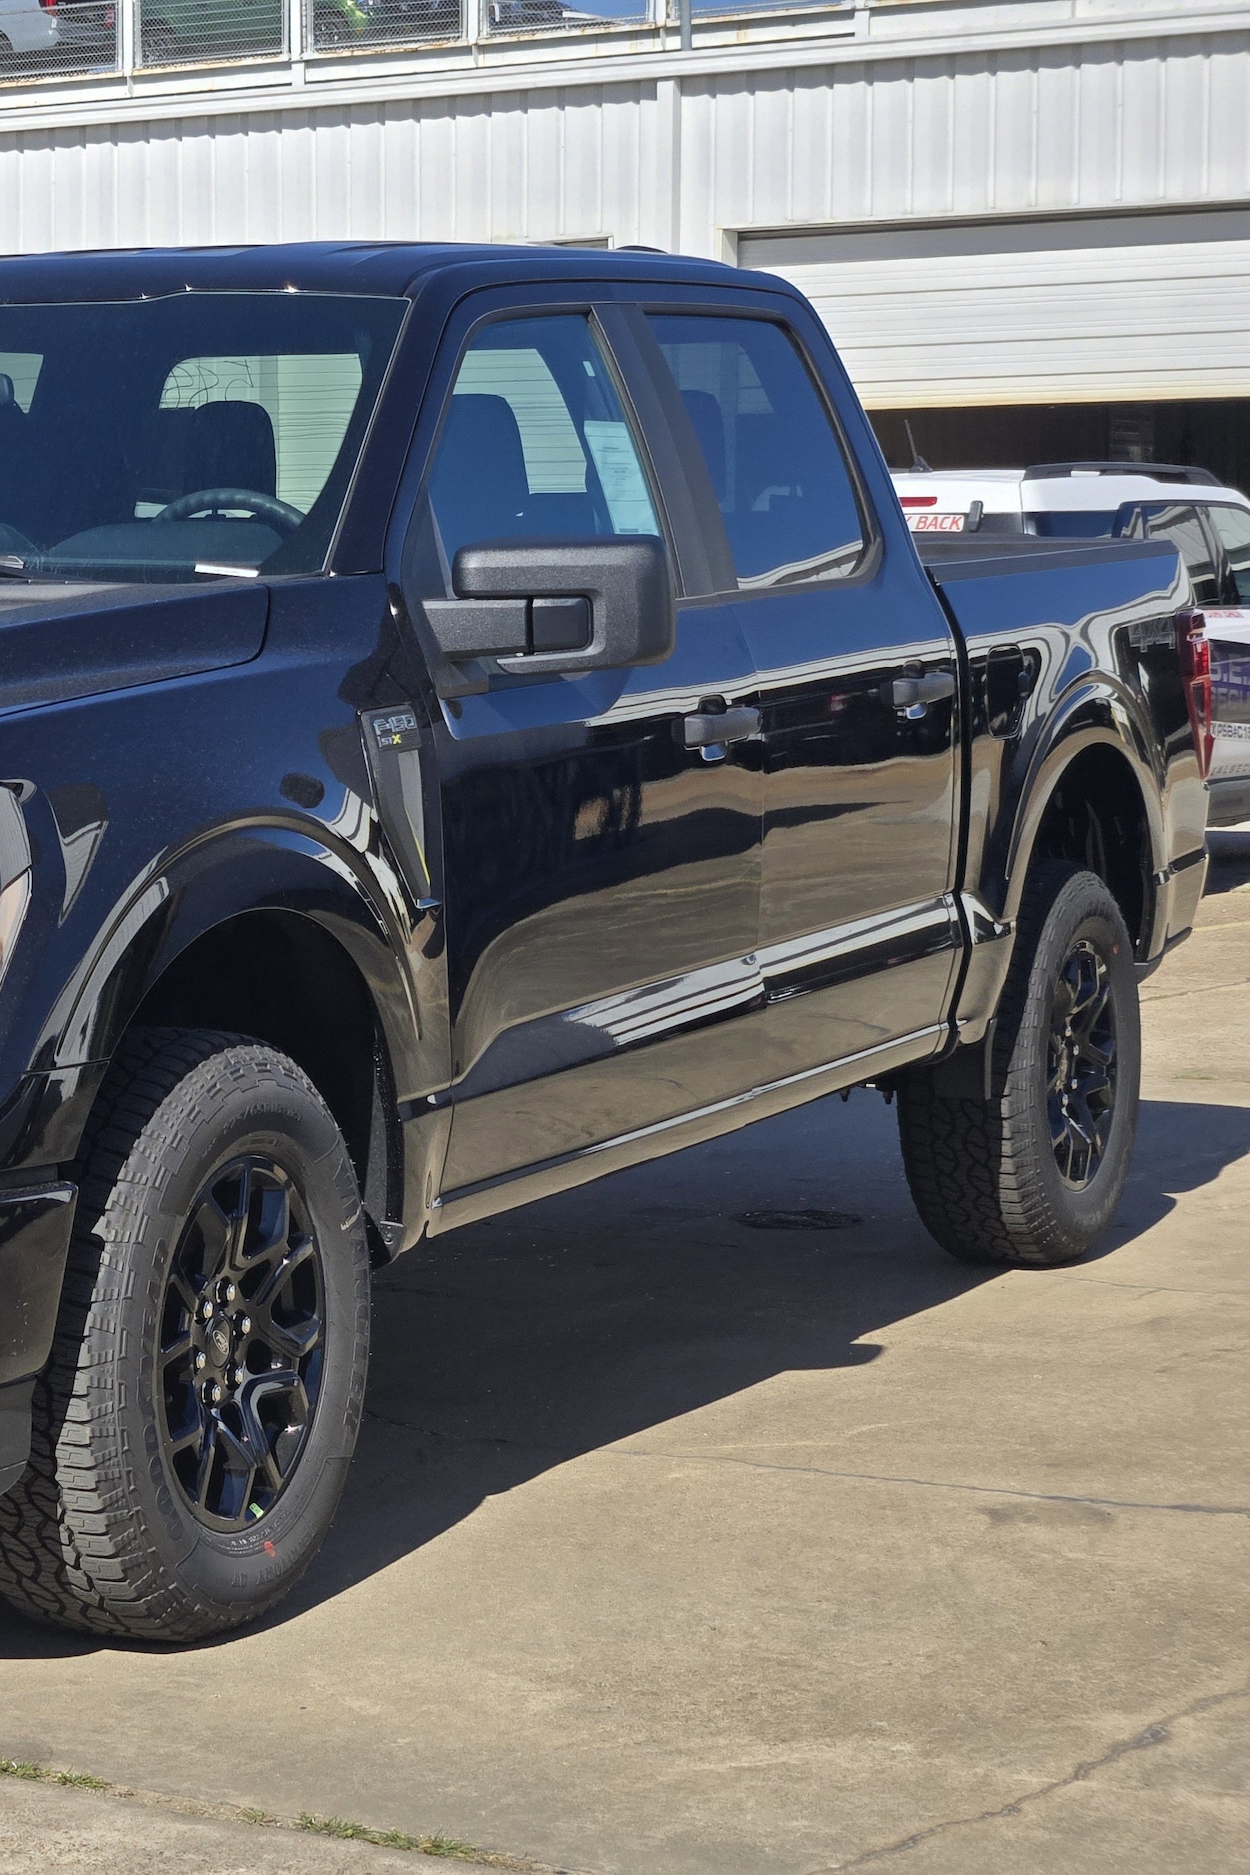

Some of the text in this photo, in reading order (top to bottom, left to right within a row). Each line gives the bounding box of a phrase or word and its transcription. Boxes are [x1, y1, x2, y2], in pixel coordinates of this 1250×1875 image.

[915, 516, 962, 530] BACK
[373, 714, 417, 735] F-150
[136, 1238, 184, 1541] GOODYEAR
